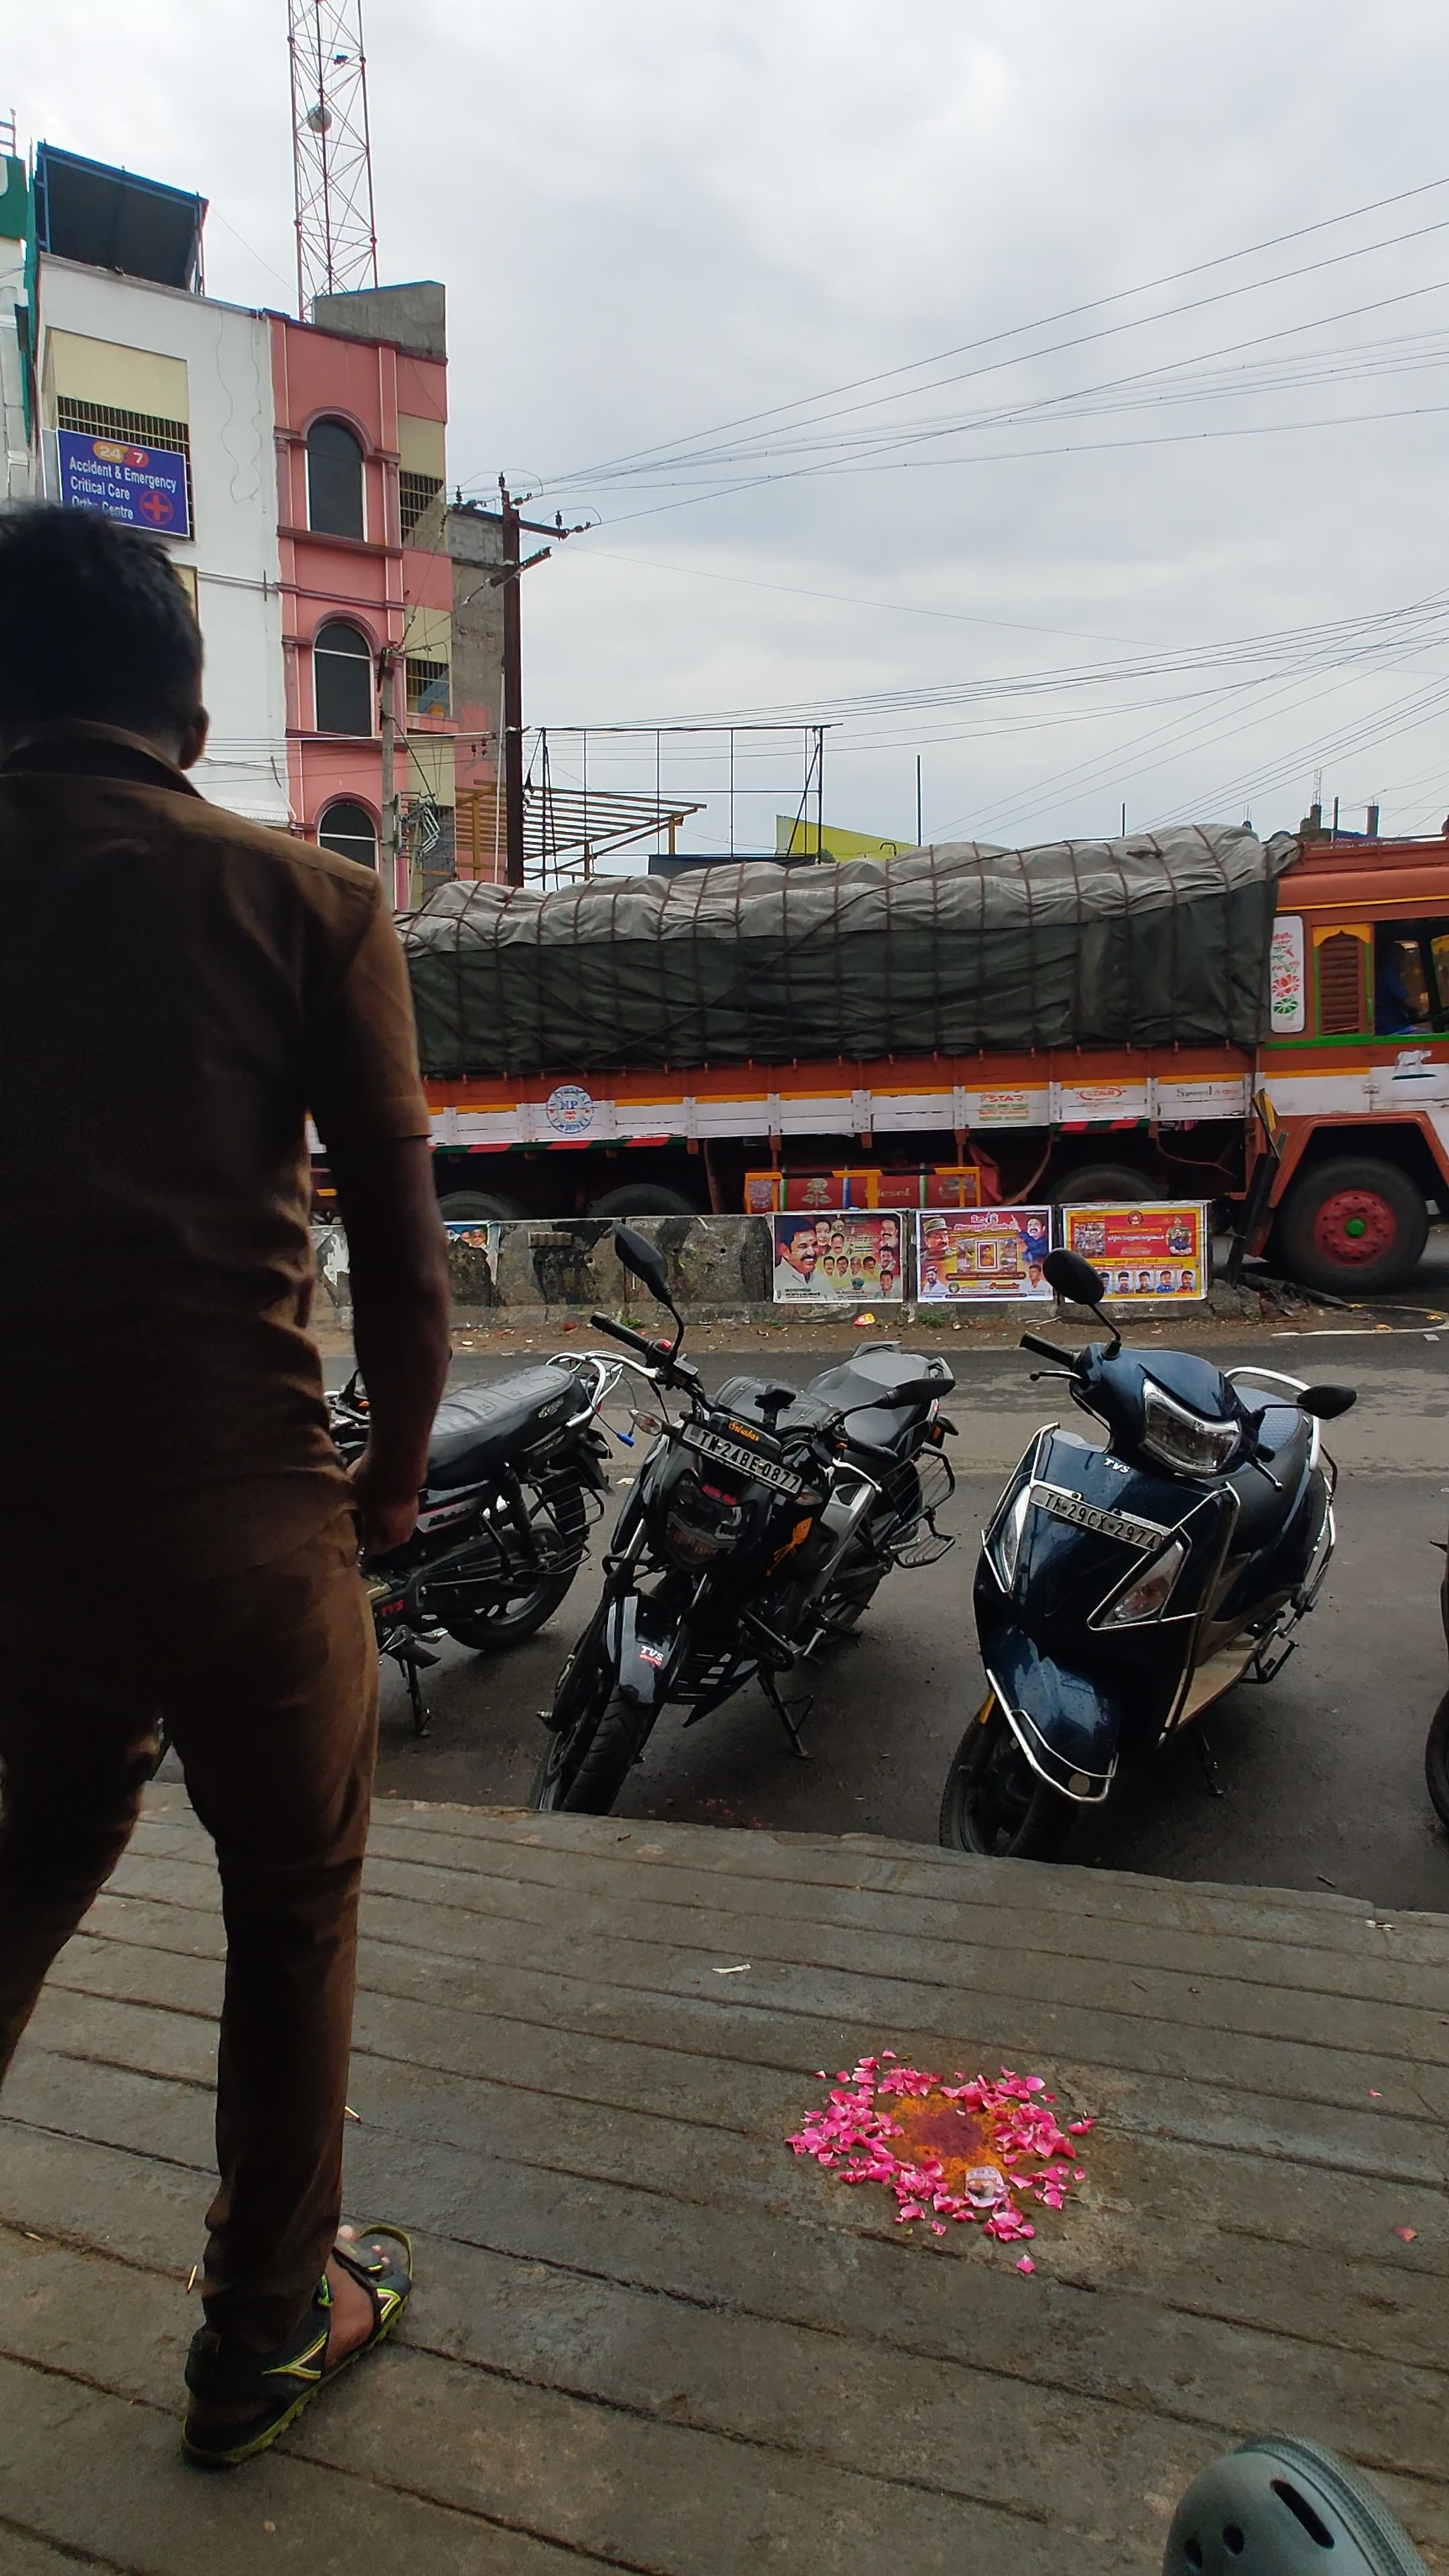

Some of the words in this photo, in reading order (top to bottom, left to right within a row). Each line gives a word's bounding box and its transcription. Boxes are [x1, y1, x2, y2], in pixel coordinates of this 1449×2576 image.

[100, 445, 121, 460] 24
[133, 452, 144, 464] 7
[70, 456, 112, 478] Accident
[115, 466, 122, 480] &
[125, 468, 177, 493] Emergency
[71, 476, 105, 496] Critical
[108, 483, 130, 500] Care
[102, 500, 133, 520] Centre
[1104, 1458, 1130, 1473] TVS
[641, 1645, 664, 1661] TVS
